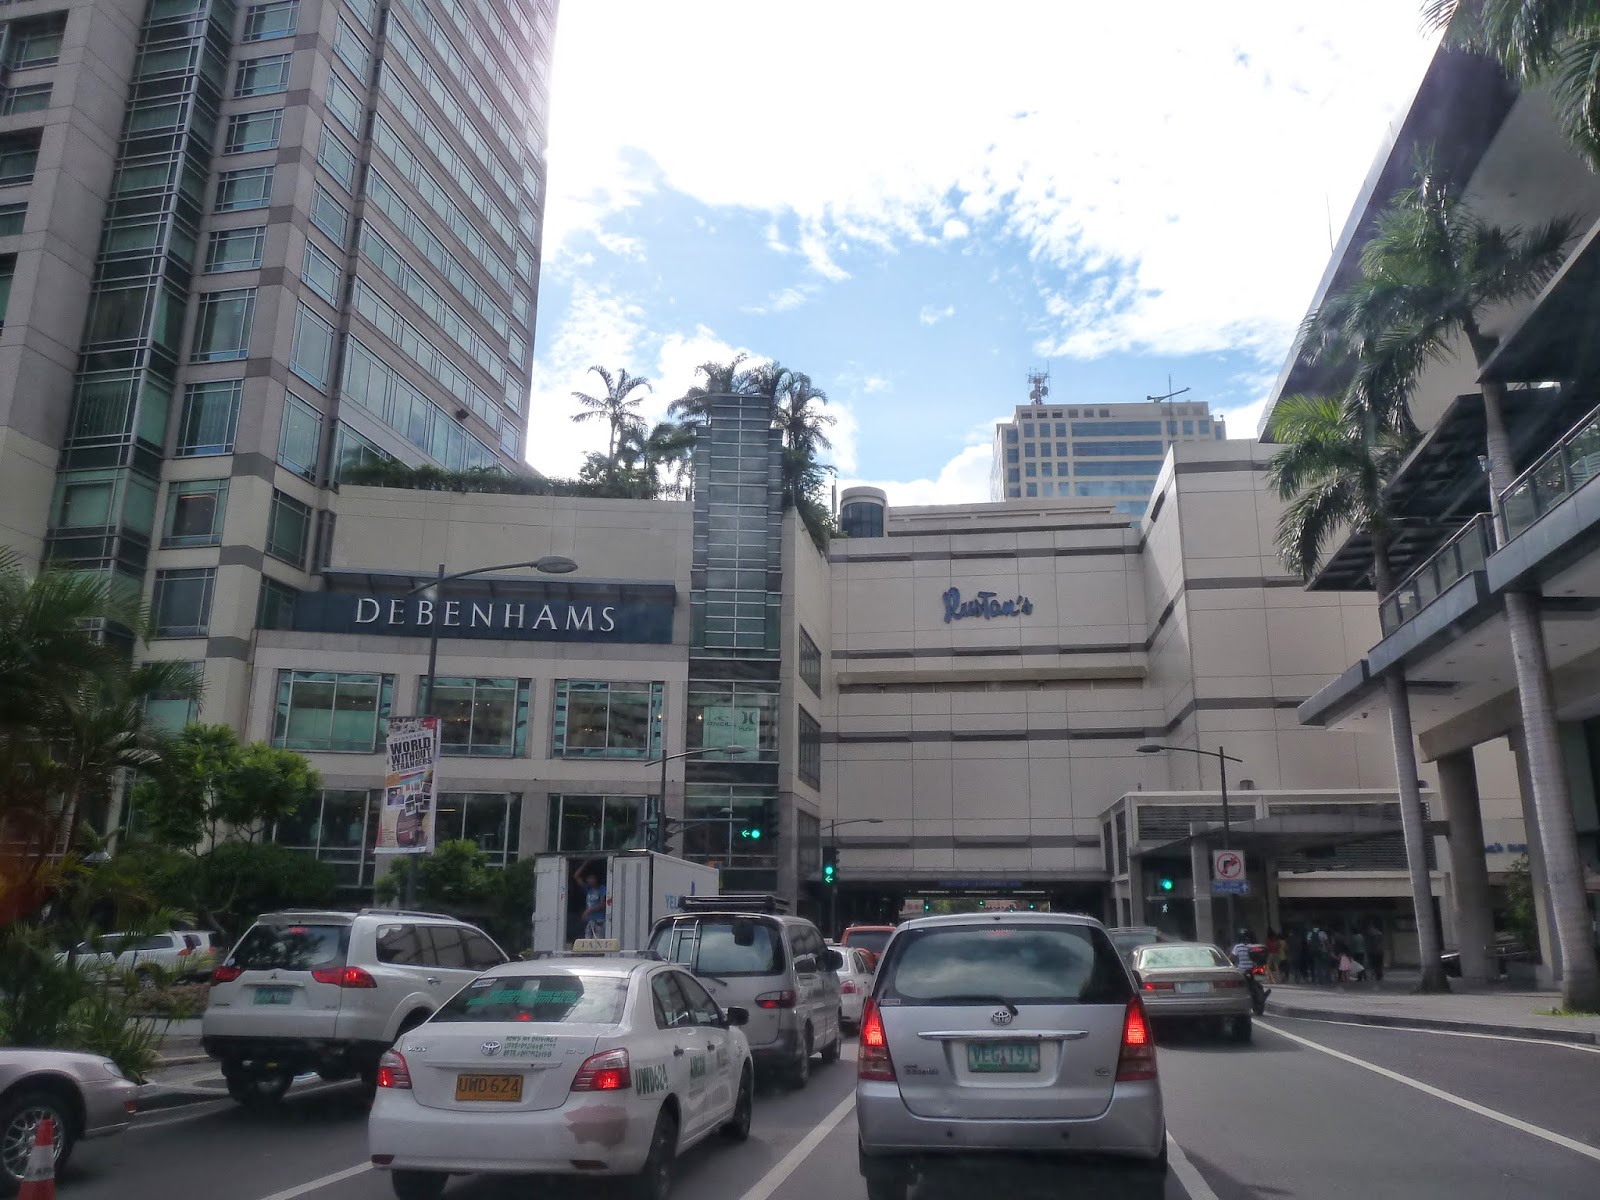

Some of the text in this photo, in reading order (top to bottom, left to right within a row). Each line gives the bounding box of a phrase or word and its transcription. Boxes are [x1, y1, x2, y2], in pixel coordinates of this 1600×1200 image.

[355, 597, 617, 633] DEBENHAMS
[390, 736, 431, 755] WORLD
[391, 747, 432, 765] WITHOUT
[391, 756, 433, 772] STRANGERS
[580, 940, 609, 949] TAXI
[973, 1046, 1033, 1063] VEG 191
[459, 1077, 519, 1093] UWD 624
